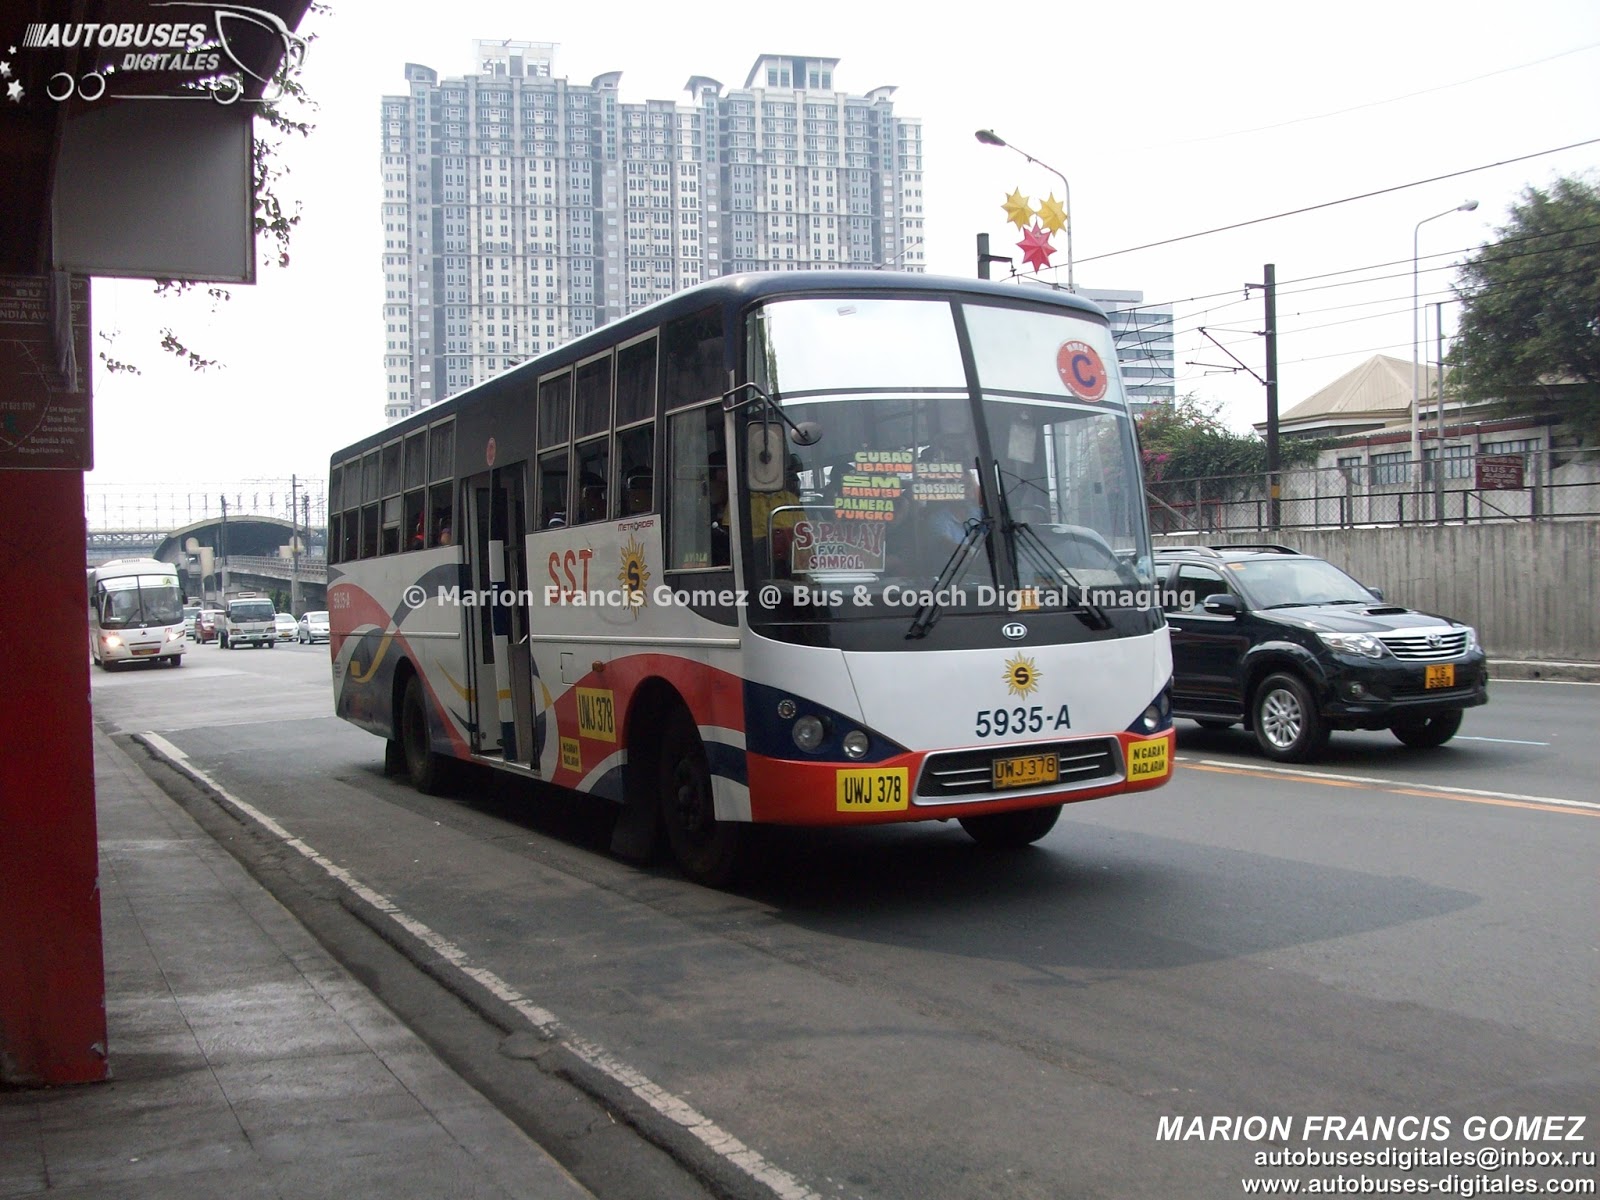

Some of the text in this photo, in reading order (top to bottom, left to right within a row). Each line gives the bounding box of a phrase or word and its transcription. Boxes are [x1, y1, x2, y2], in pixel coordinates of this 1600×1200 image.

[1072, 354, 1096, 388] C
[855, 451, 913, 463] CUBAO
[856, 463, 914, 473] IBABAW
[915, 463, 963, 473] BONI
[843, 475, 900, 488] SM
[912, 483, 965, 494] CROSSING
[834, 497, 895, 512] PALMERA
[835, 509, 895, 521] TUNGKO
[809, 555, 864, 570] SAMPOL
[548, 548, 593, 604] SST
[596, 696, 613, 733] 378
[975, 704, 1071, 738] 5935-A
[844, 775, 901, 804] UWJ 378
